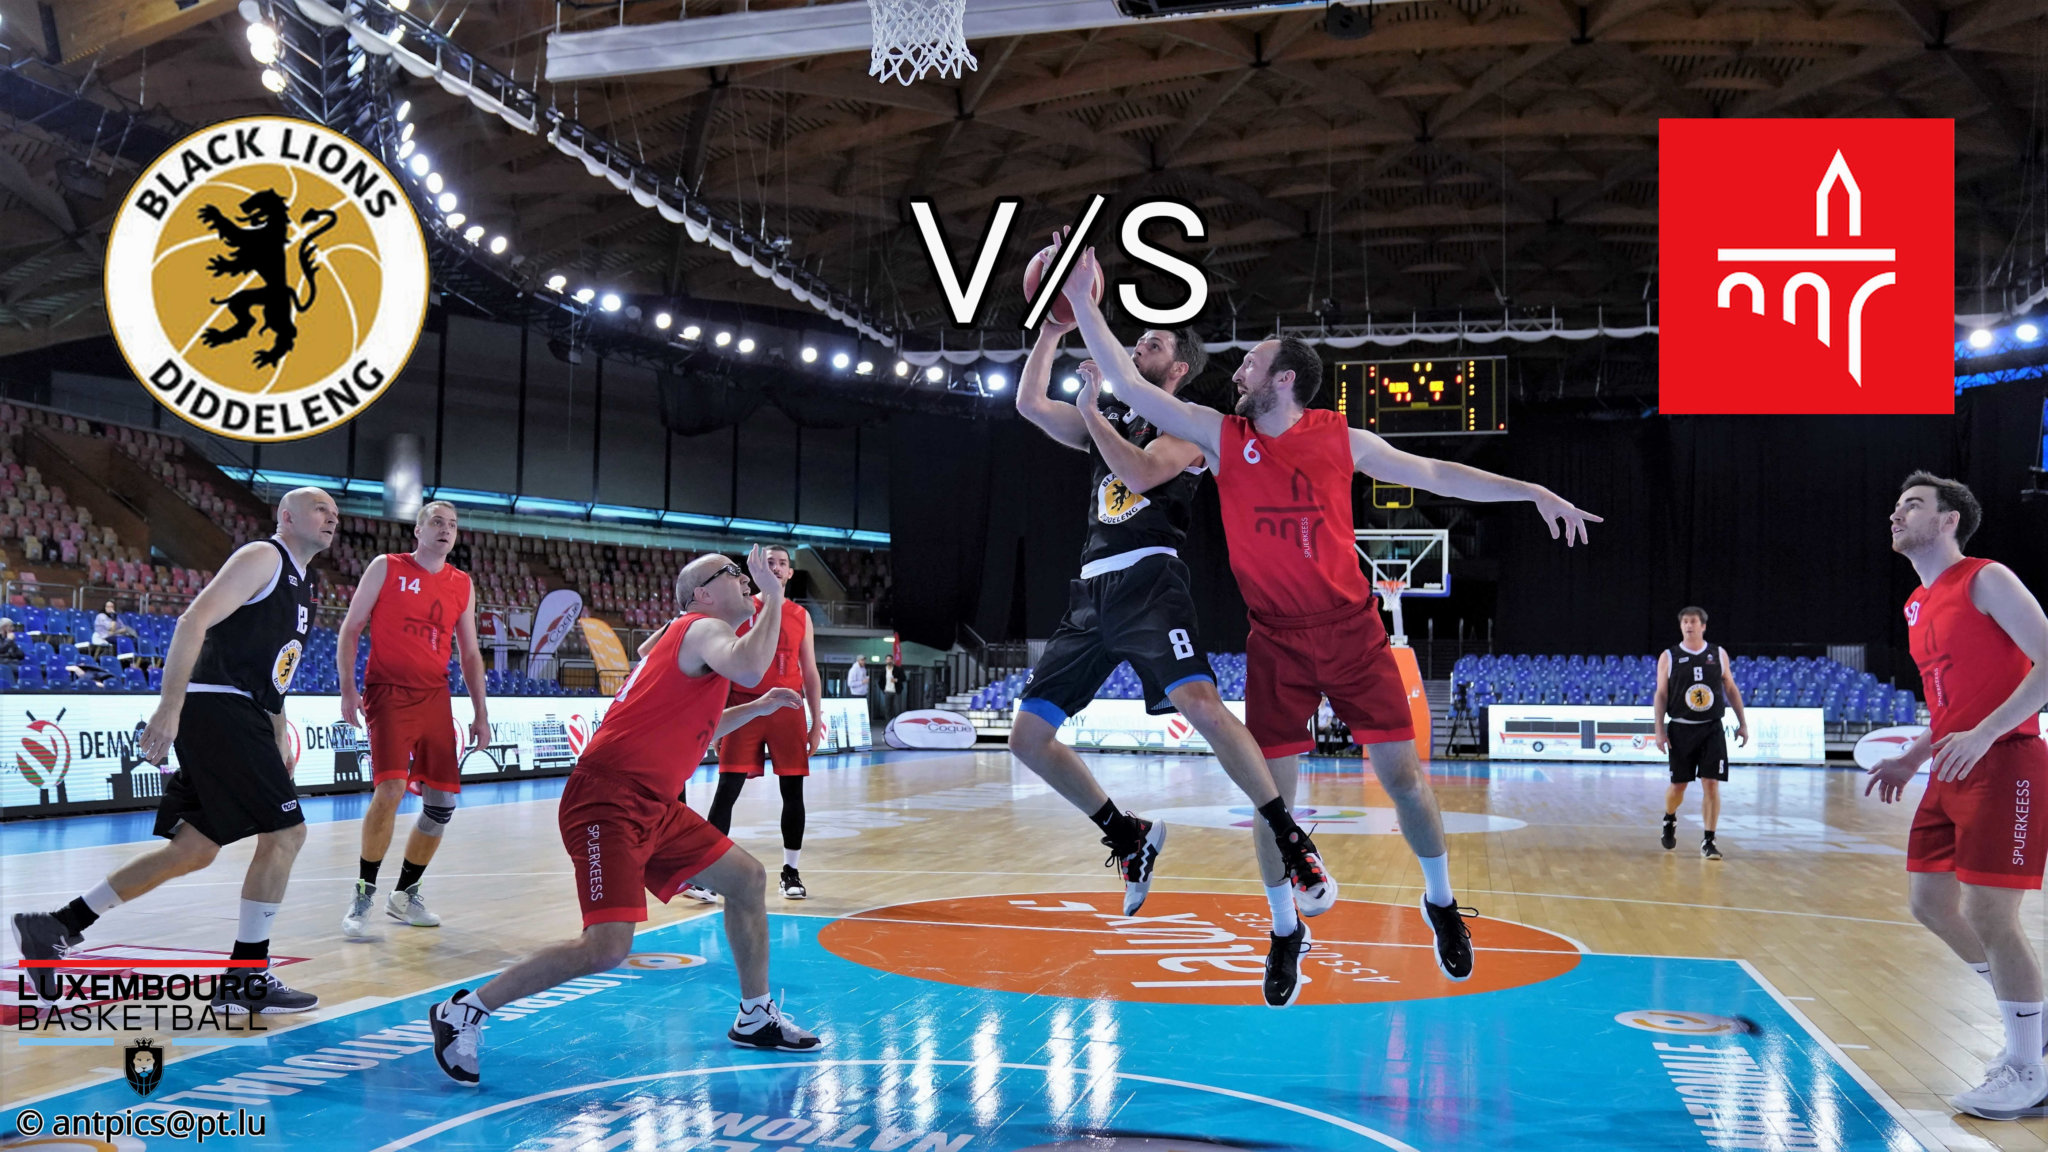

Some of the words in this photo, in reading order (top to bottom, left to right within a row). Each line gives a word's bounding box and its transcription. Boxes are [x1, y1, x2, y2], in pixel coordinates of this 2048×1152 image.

[1243, 438, 1261, 464] 6
[1100, 506, 1139, 524] DDDELENG
[1301, 516, 1312, 558] SPUERKEESS
[398, 575, 421, 595] 14
[482, 619, 493, 628] WC
[549, 602, 581, 643] Coque
[1168, 628, 1195, 661] 8
[928, 722, 972, 734] Coque
[1062, 715, 1087, 727] EMY
[306, 726, 347, 750] DEMY
[2012, 779, 2030, 866] SPUERKEESS
[587, 824, 604, 901] SPUERKEESS
[1225, 912, 1401, 983] ASSUCES
[115, 1019, 492, 1117] ATIONALE
